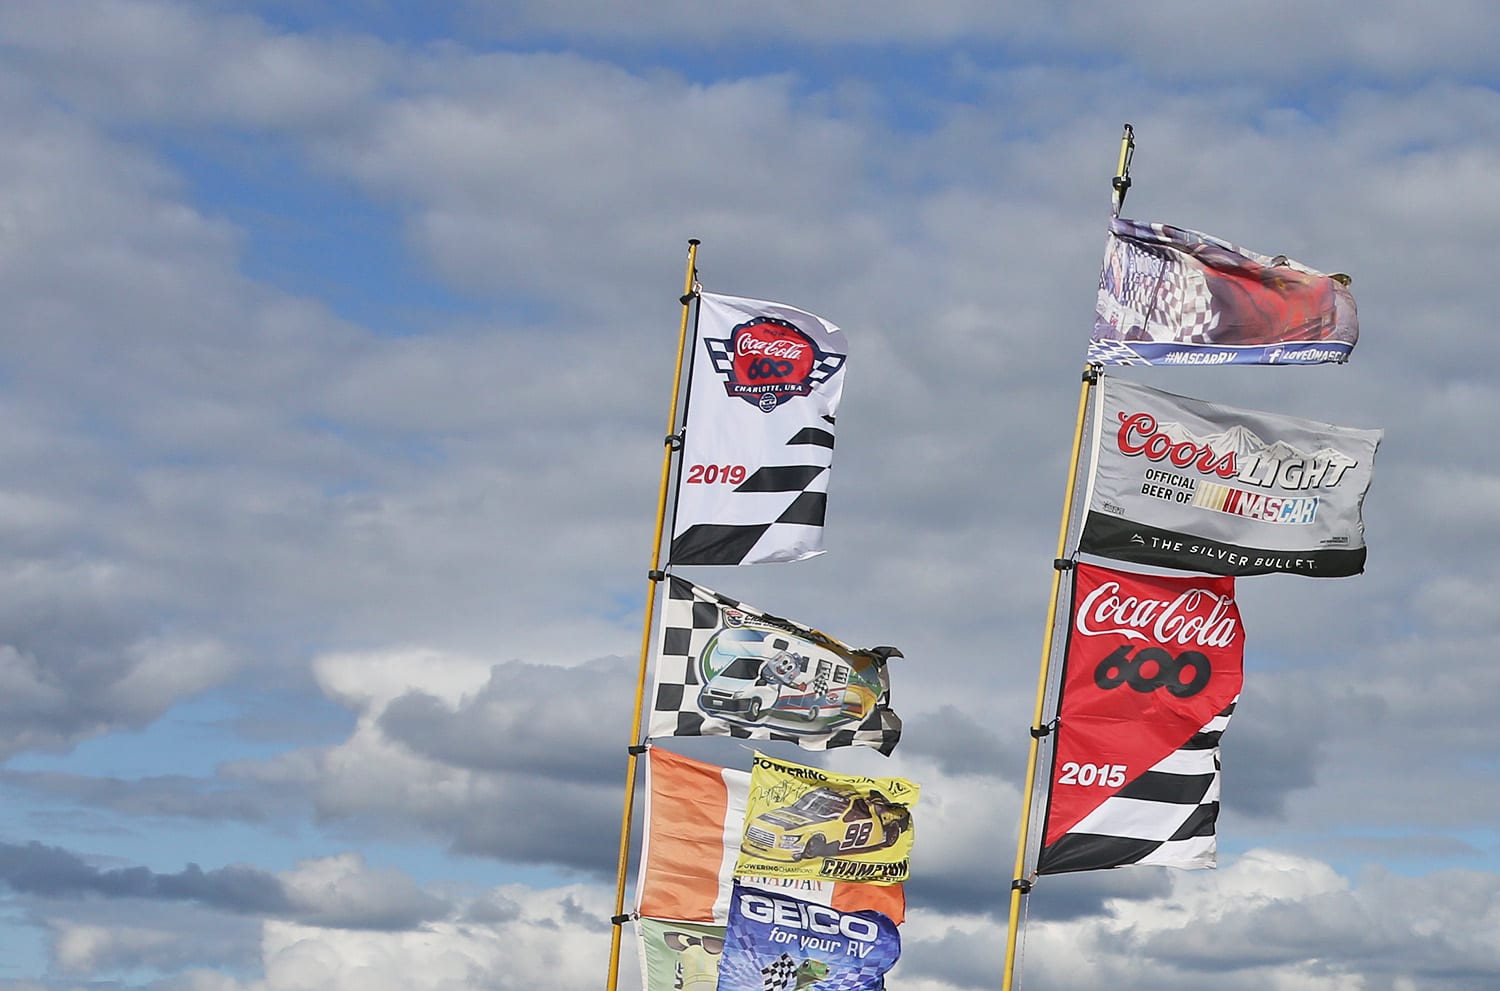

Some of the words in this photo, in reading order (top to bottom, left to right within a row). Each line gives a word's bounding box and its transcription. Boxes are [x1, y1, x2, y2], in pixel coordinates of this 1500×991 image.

[737, 333, 807, 360] Coca-Cola
[747, 357, 794, 380] 600
[785, 383, 803, 393] USA
[1117, 411, 1239, 478] Coors
[1236, 457, 1357, 490] LIGHT
[687, 464, 747, 485] 2019
[1145, 468, 1195, 490] OFFICIAL
[1141, 483, 1173, 500] BEER
[1176, 491, 1193, 504] OF
[1234, 492, 1320, 525] NASCAR
[1150, 537, 1183, 552] THE
[1189, 543, 1250, 567] SILVER
[1076, 581, 1236, 648] Coca-Cola
[1093, 645, 1212, 698] 600
[1058, 762, 1127, 788] 2015
[841, 822, 875, 850] 98
[739, 894, 879, 943] GEICO
[768, 927, 798, 944] for
[799, 936, 841, 954] your
[846, 941, 875, 959] RV
